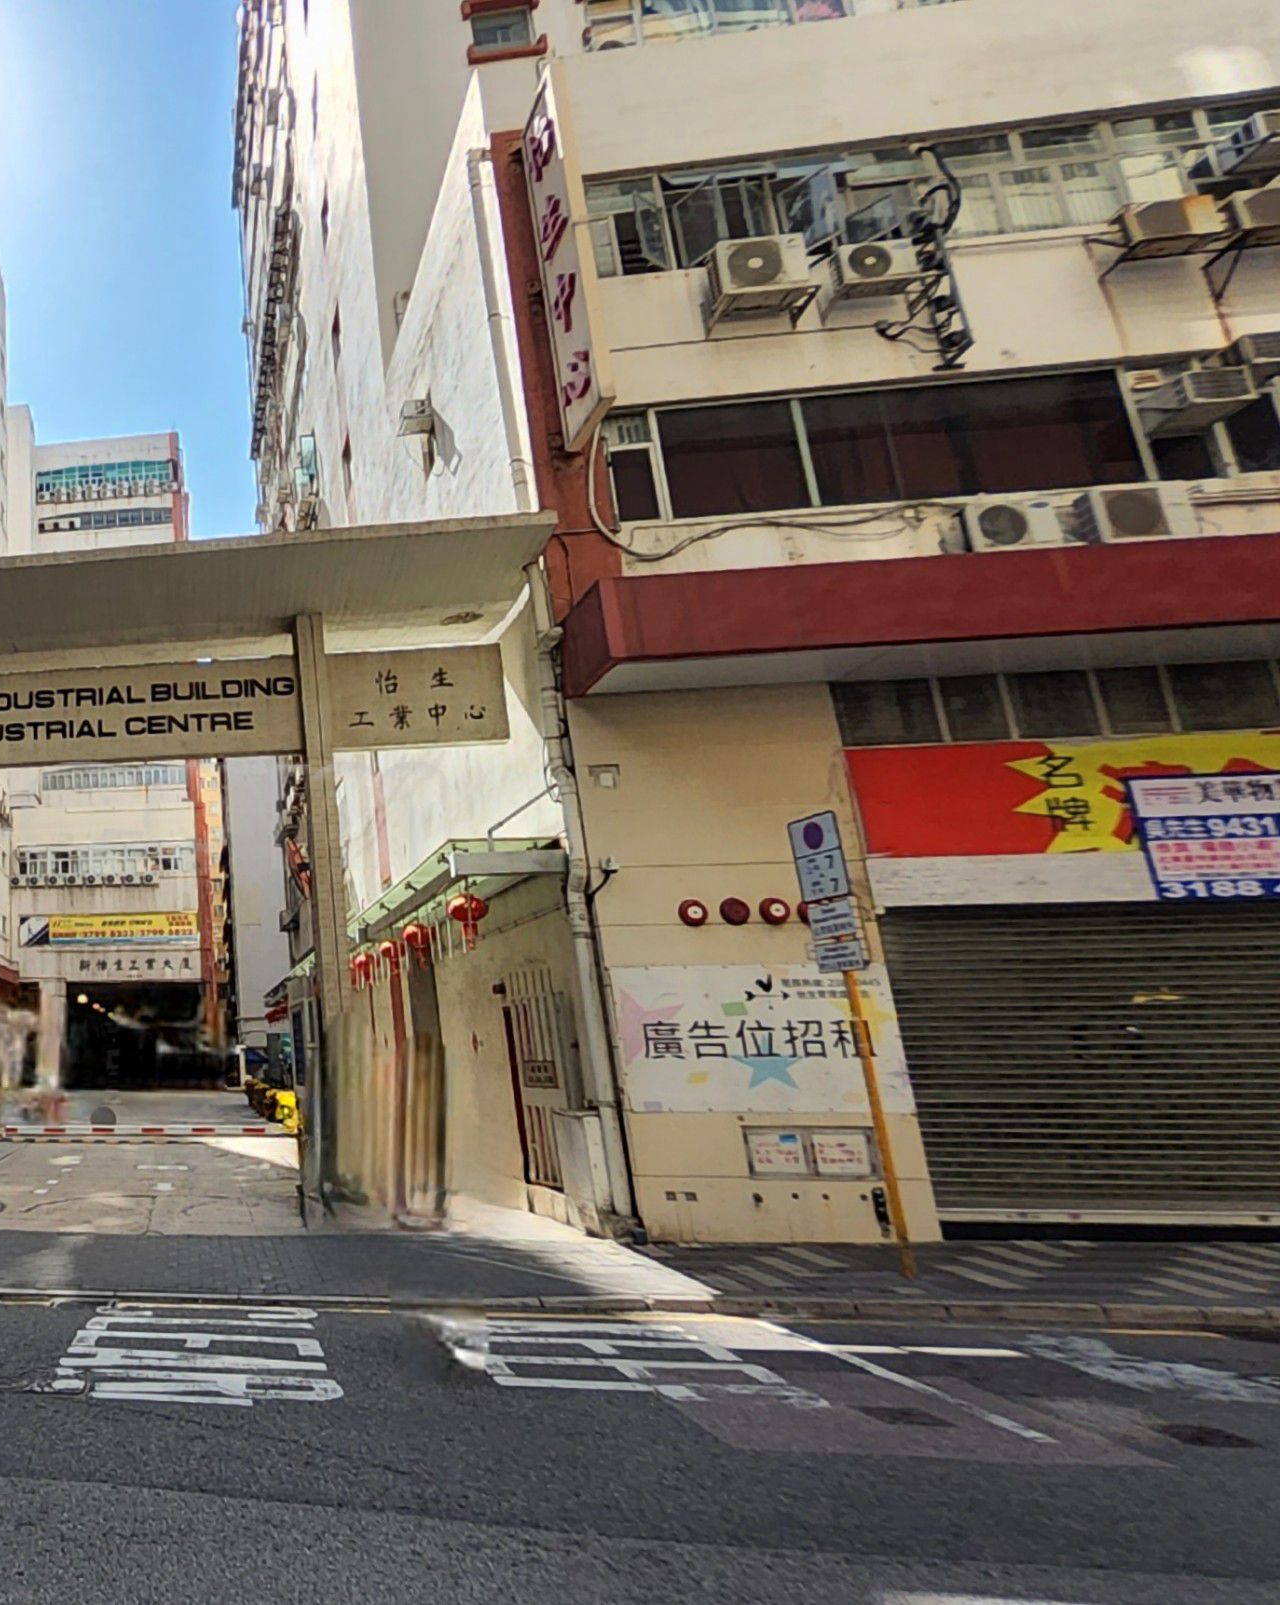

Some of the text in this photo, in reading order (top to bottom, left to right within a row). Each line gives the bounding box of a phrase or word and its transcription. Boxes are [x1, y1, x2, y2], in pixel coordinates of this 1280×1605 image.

[151, 676, 295, 703] BUILDING
[375, 667, 454, 694] 怡生
[125, 711, 254, 736] CENTRE
[349, 702, 486, 730] 工業中心
[1207, 816, 1278, 837] 9431
[824, 854, 834, 869] 7
[829, 878, 839, 893] 7
[1159, 880, 1266, 899] 3188
[642, 1019, 879, 1060] 廣告位招租
[55, 1301, 345, 1406] CLEAR
